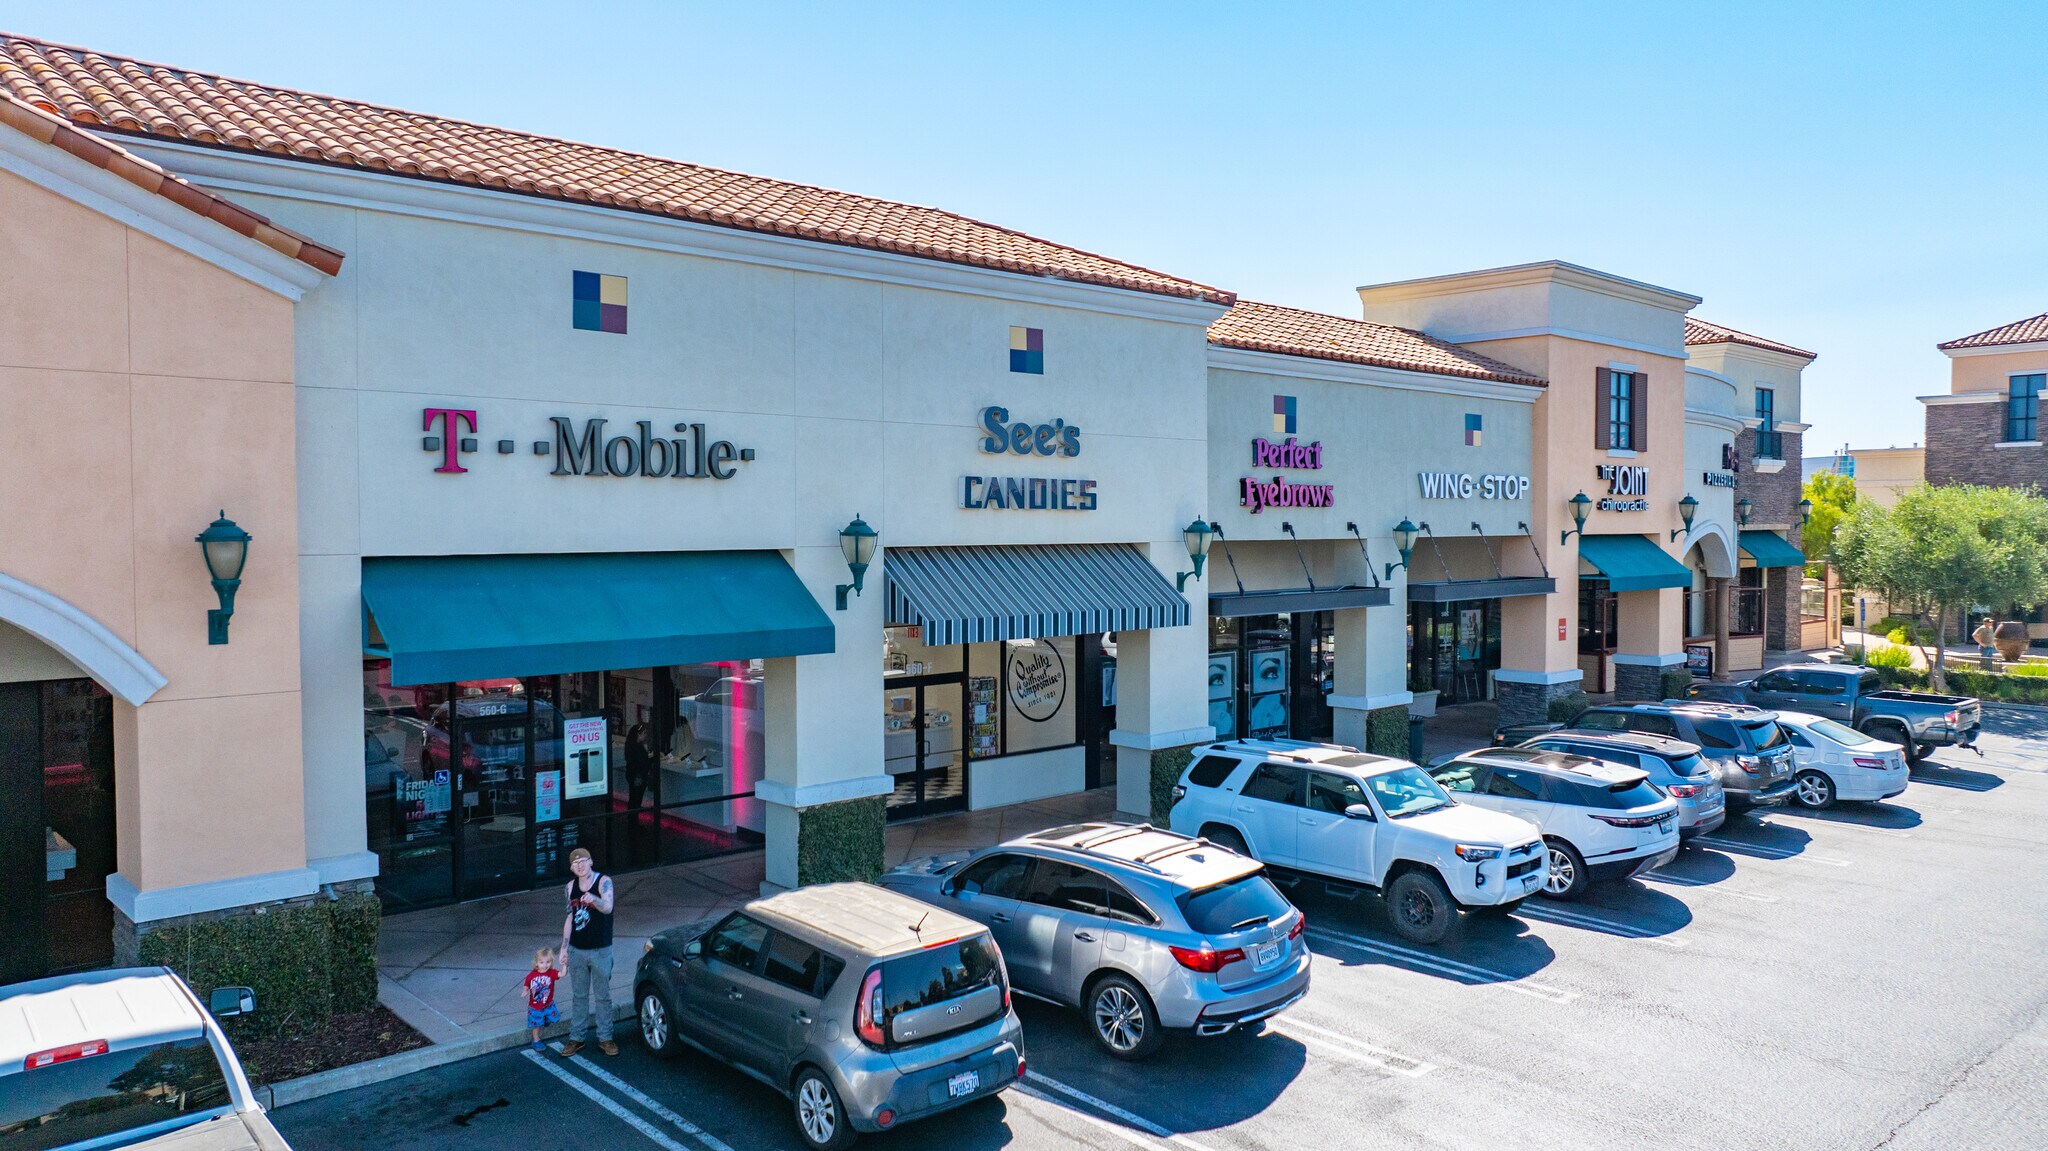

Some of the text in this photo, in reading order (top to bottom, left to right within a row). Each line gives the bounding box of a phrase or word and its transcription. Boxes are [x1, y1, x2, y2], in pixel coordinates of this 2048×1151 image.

[978, 406, 1080, 457] See's
[1252, 437, 1323, 469] Perfect
[959, 476, 1097, 510] CANDIES
[1611, 465, 1649, 495] JOINT
[1240, 476, 1334, 514] Eyebrows
[1598, 498, 1649, 512] chiropractic
[1016, 653, 1053, 681] Quality
[480, 704, 507, 716] 560-G
[572, 734, 586, 744] ON
[588, 732, 600, 742] US
[406, 780, 439, 791] FRIDA
